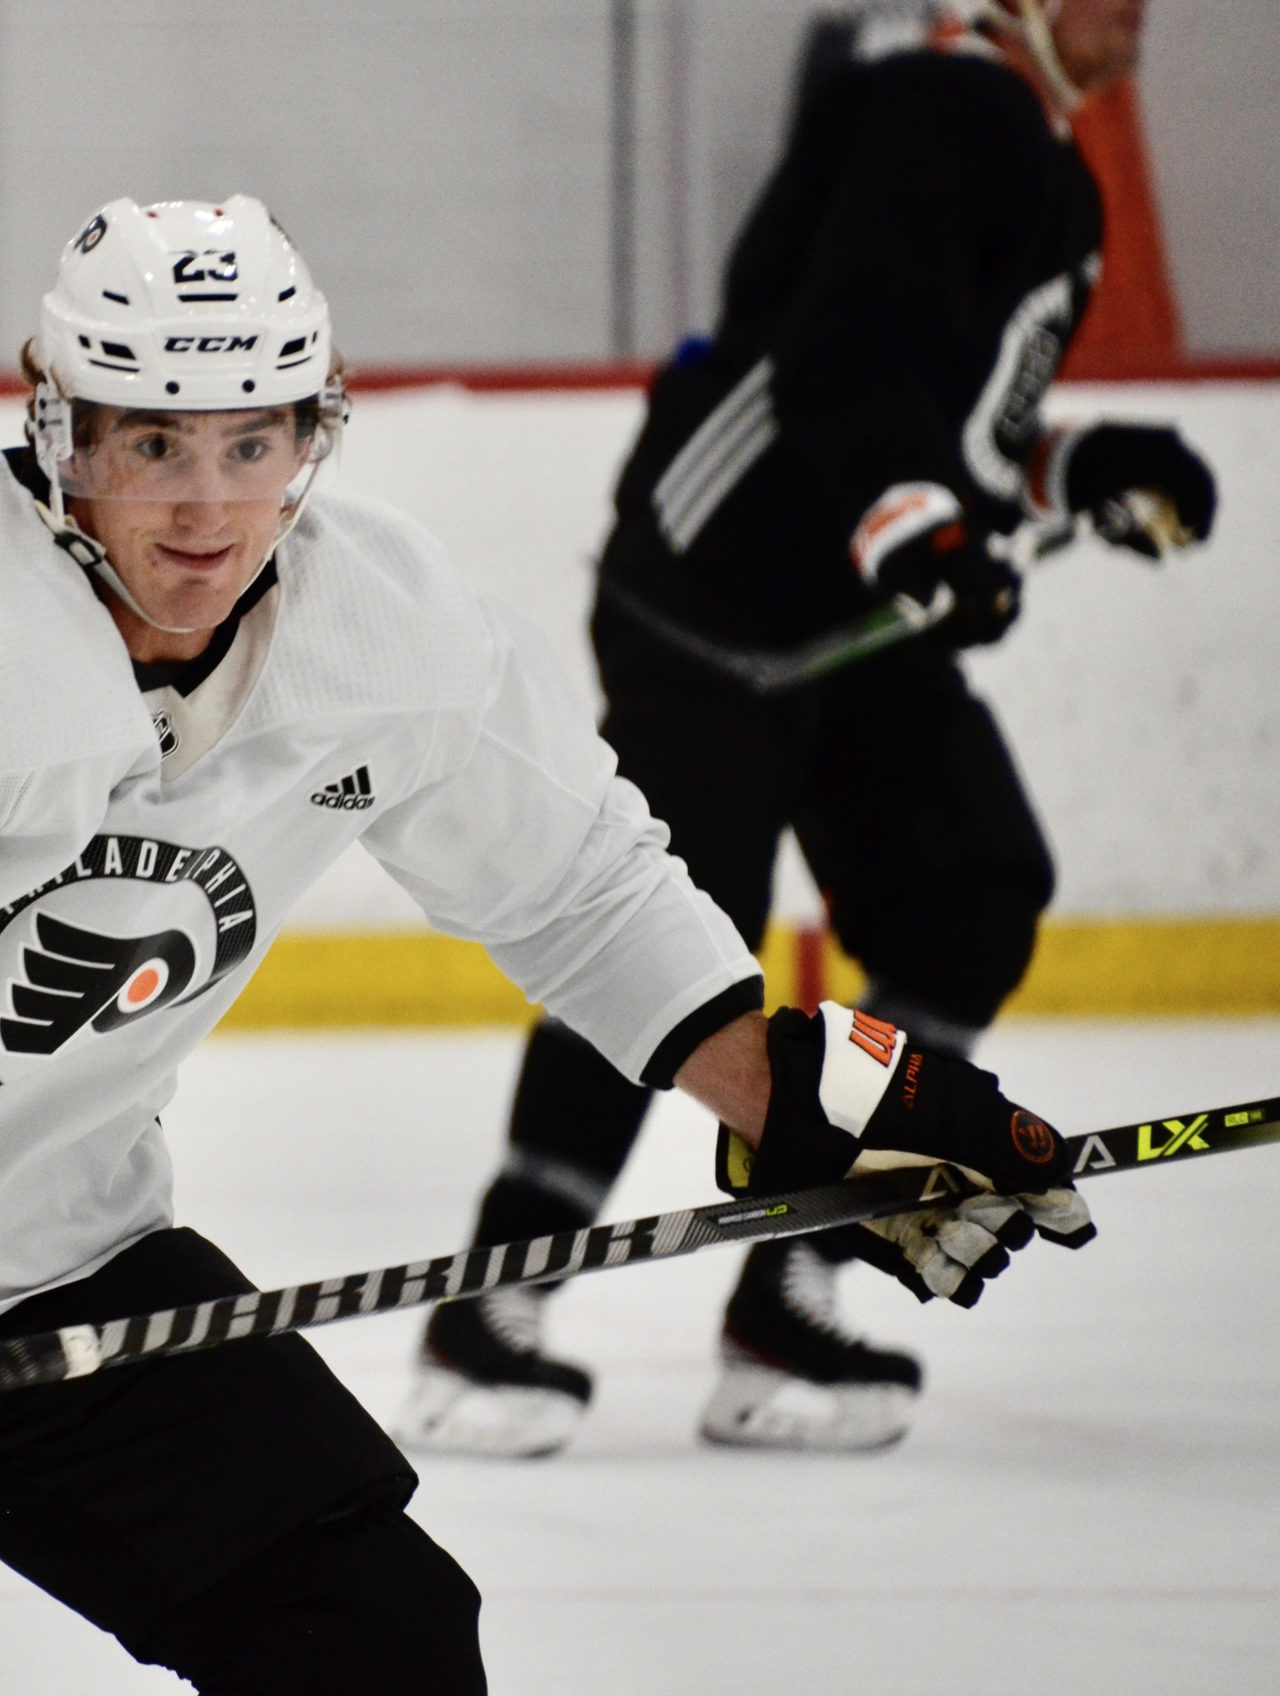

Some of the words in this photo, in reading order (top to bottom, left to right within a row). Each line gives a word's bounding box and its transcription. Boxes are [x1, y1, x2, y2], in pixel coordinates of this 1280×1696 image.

[172, 249, 239, 283] 23
[163, 335, 259, 352] CCM
[310, 793, 375, 811] adidas
[4, 837, 254, 934] LADEPHIA
[1137, 1114, 1210, 1161] LX
